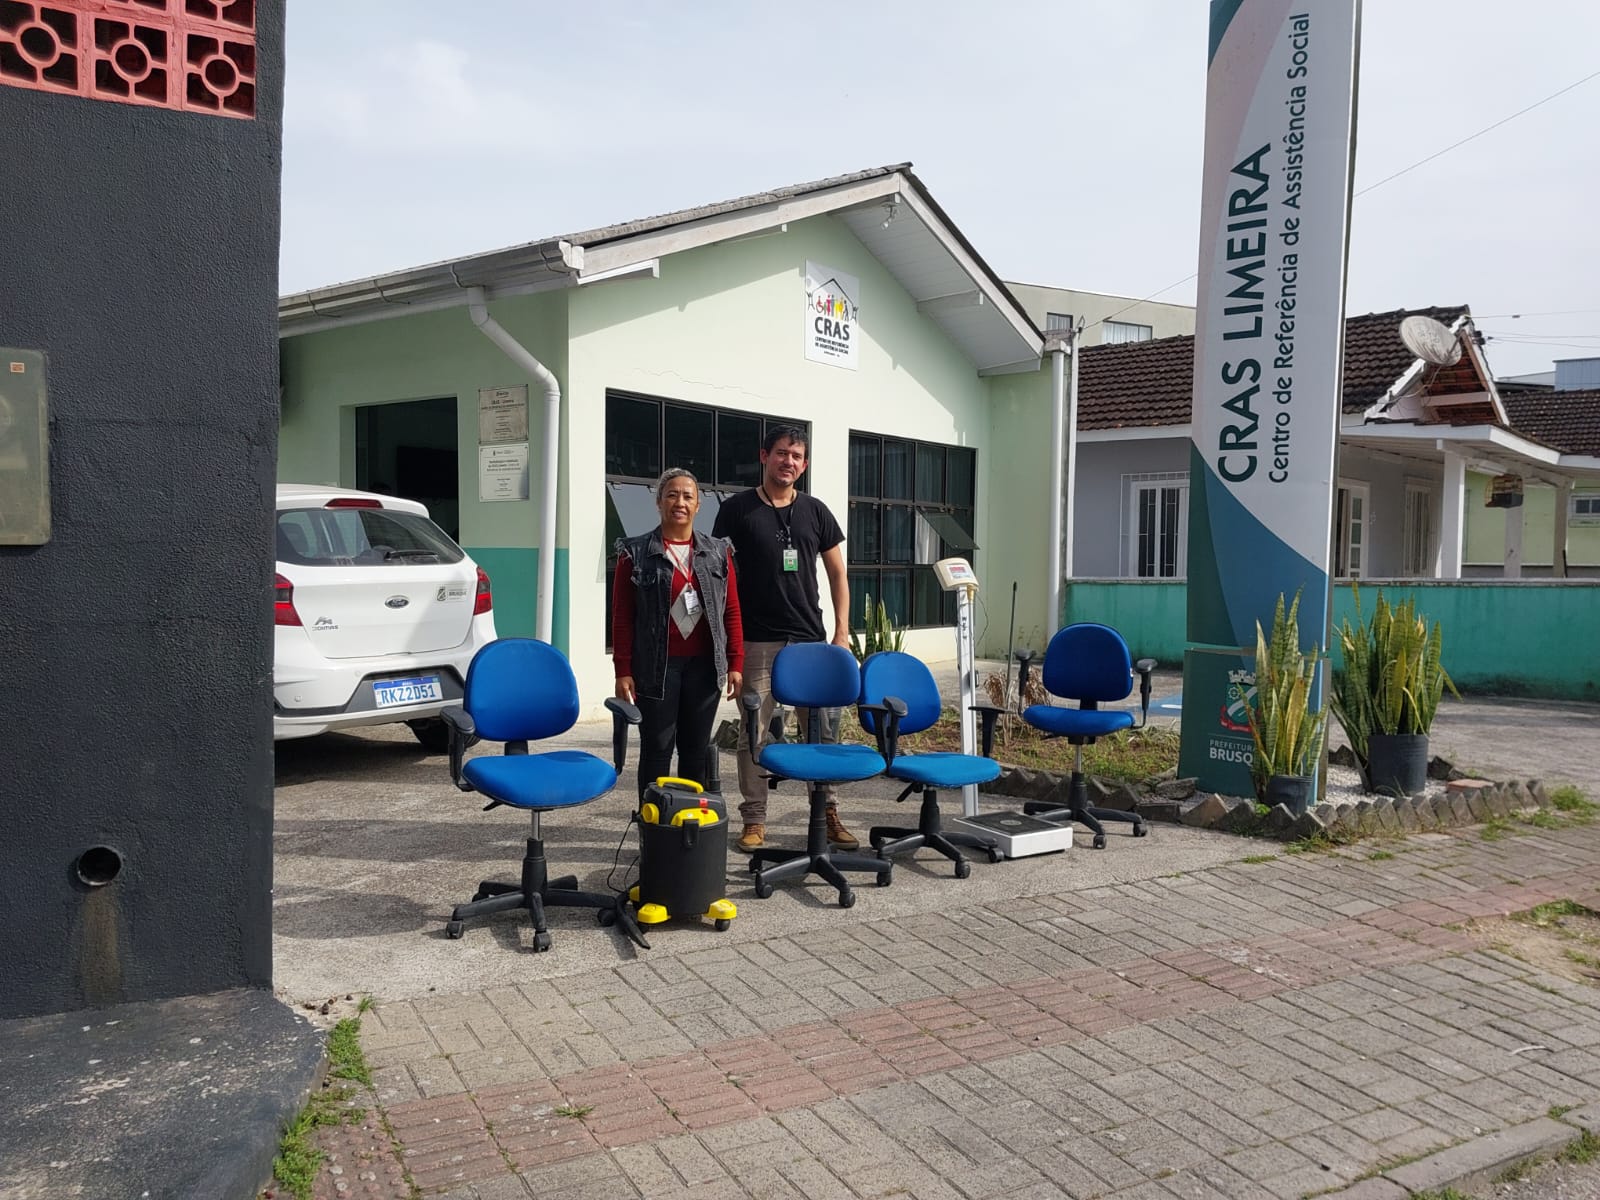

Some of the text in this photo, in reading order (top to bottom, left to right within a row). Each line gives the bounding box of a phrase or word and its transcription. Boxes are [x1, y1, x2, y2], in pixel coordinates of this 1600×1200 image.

[1268, 13, 1309, 483] Centro de Referência de Assistência Social
[1218, 142, 1271, 482] CRAS LIMEIRA
[815, 317, 850, 341] CRAS
[381, 684, 436, 704] RKZ2D51
[1210, 739, 1256, 752] PREFEITUR
[1210, 747, 1254, 768] BRUSQ
